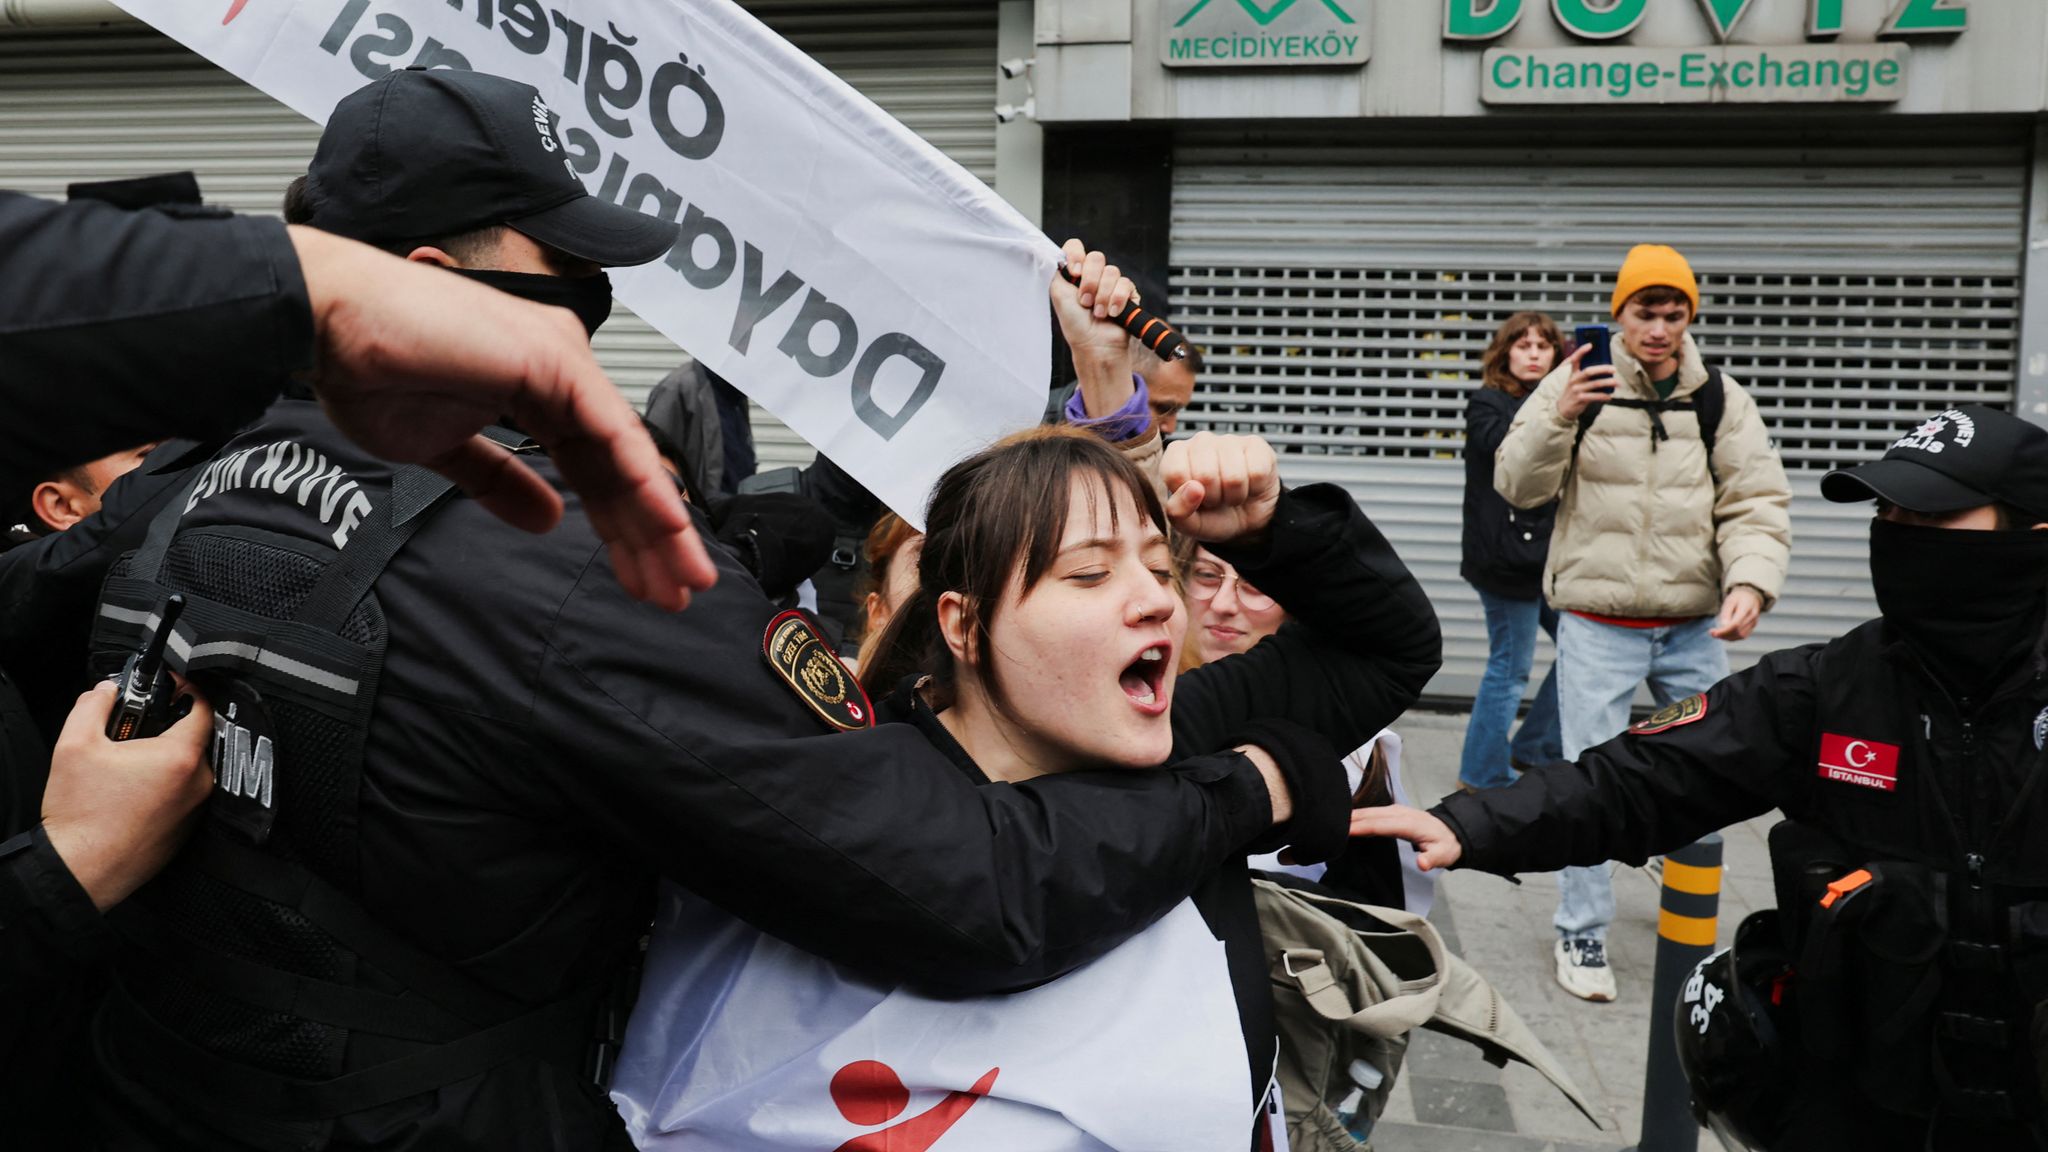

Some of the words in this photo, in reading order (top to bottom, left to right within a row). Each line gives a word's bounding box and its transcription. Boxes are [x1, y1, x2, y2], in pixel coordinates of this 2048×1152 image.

[1169, 30, 1359, 60] MECİDİYEKÖY
[1491, 53, 1900, 97] Change-Exchange
[249, 440, 373, 550] KUVVE
[1690, 982, 1725, 1035] 34
